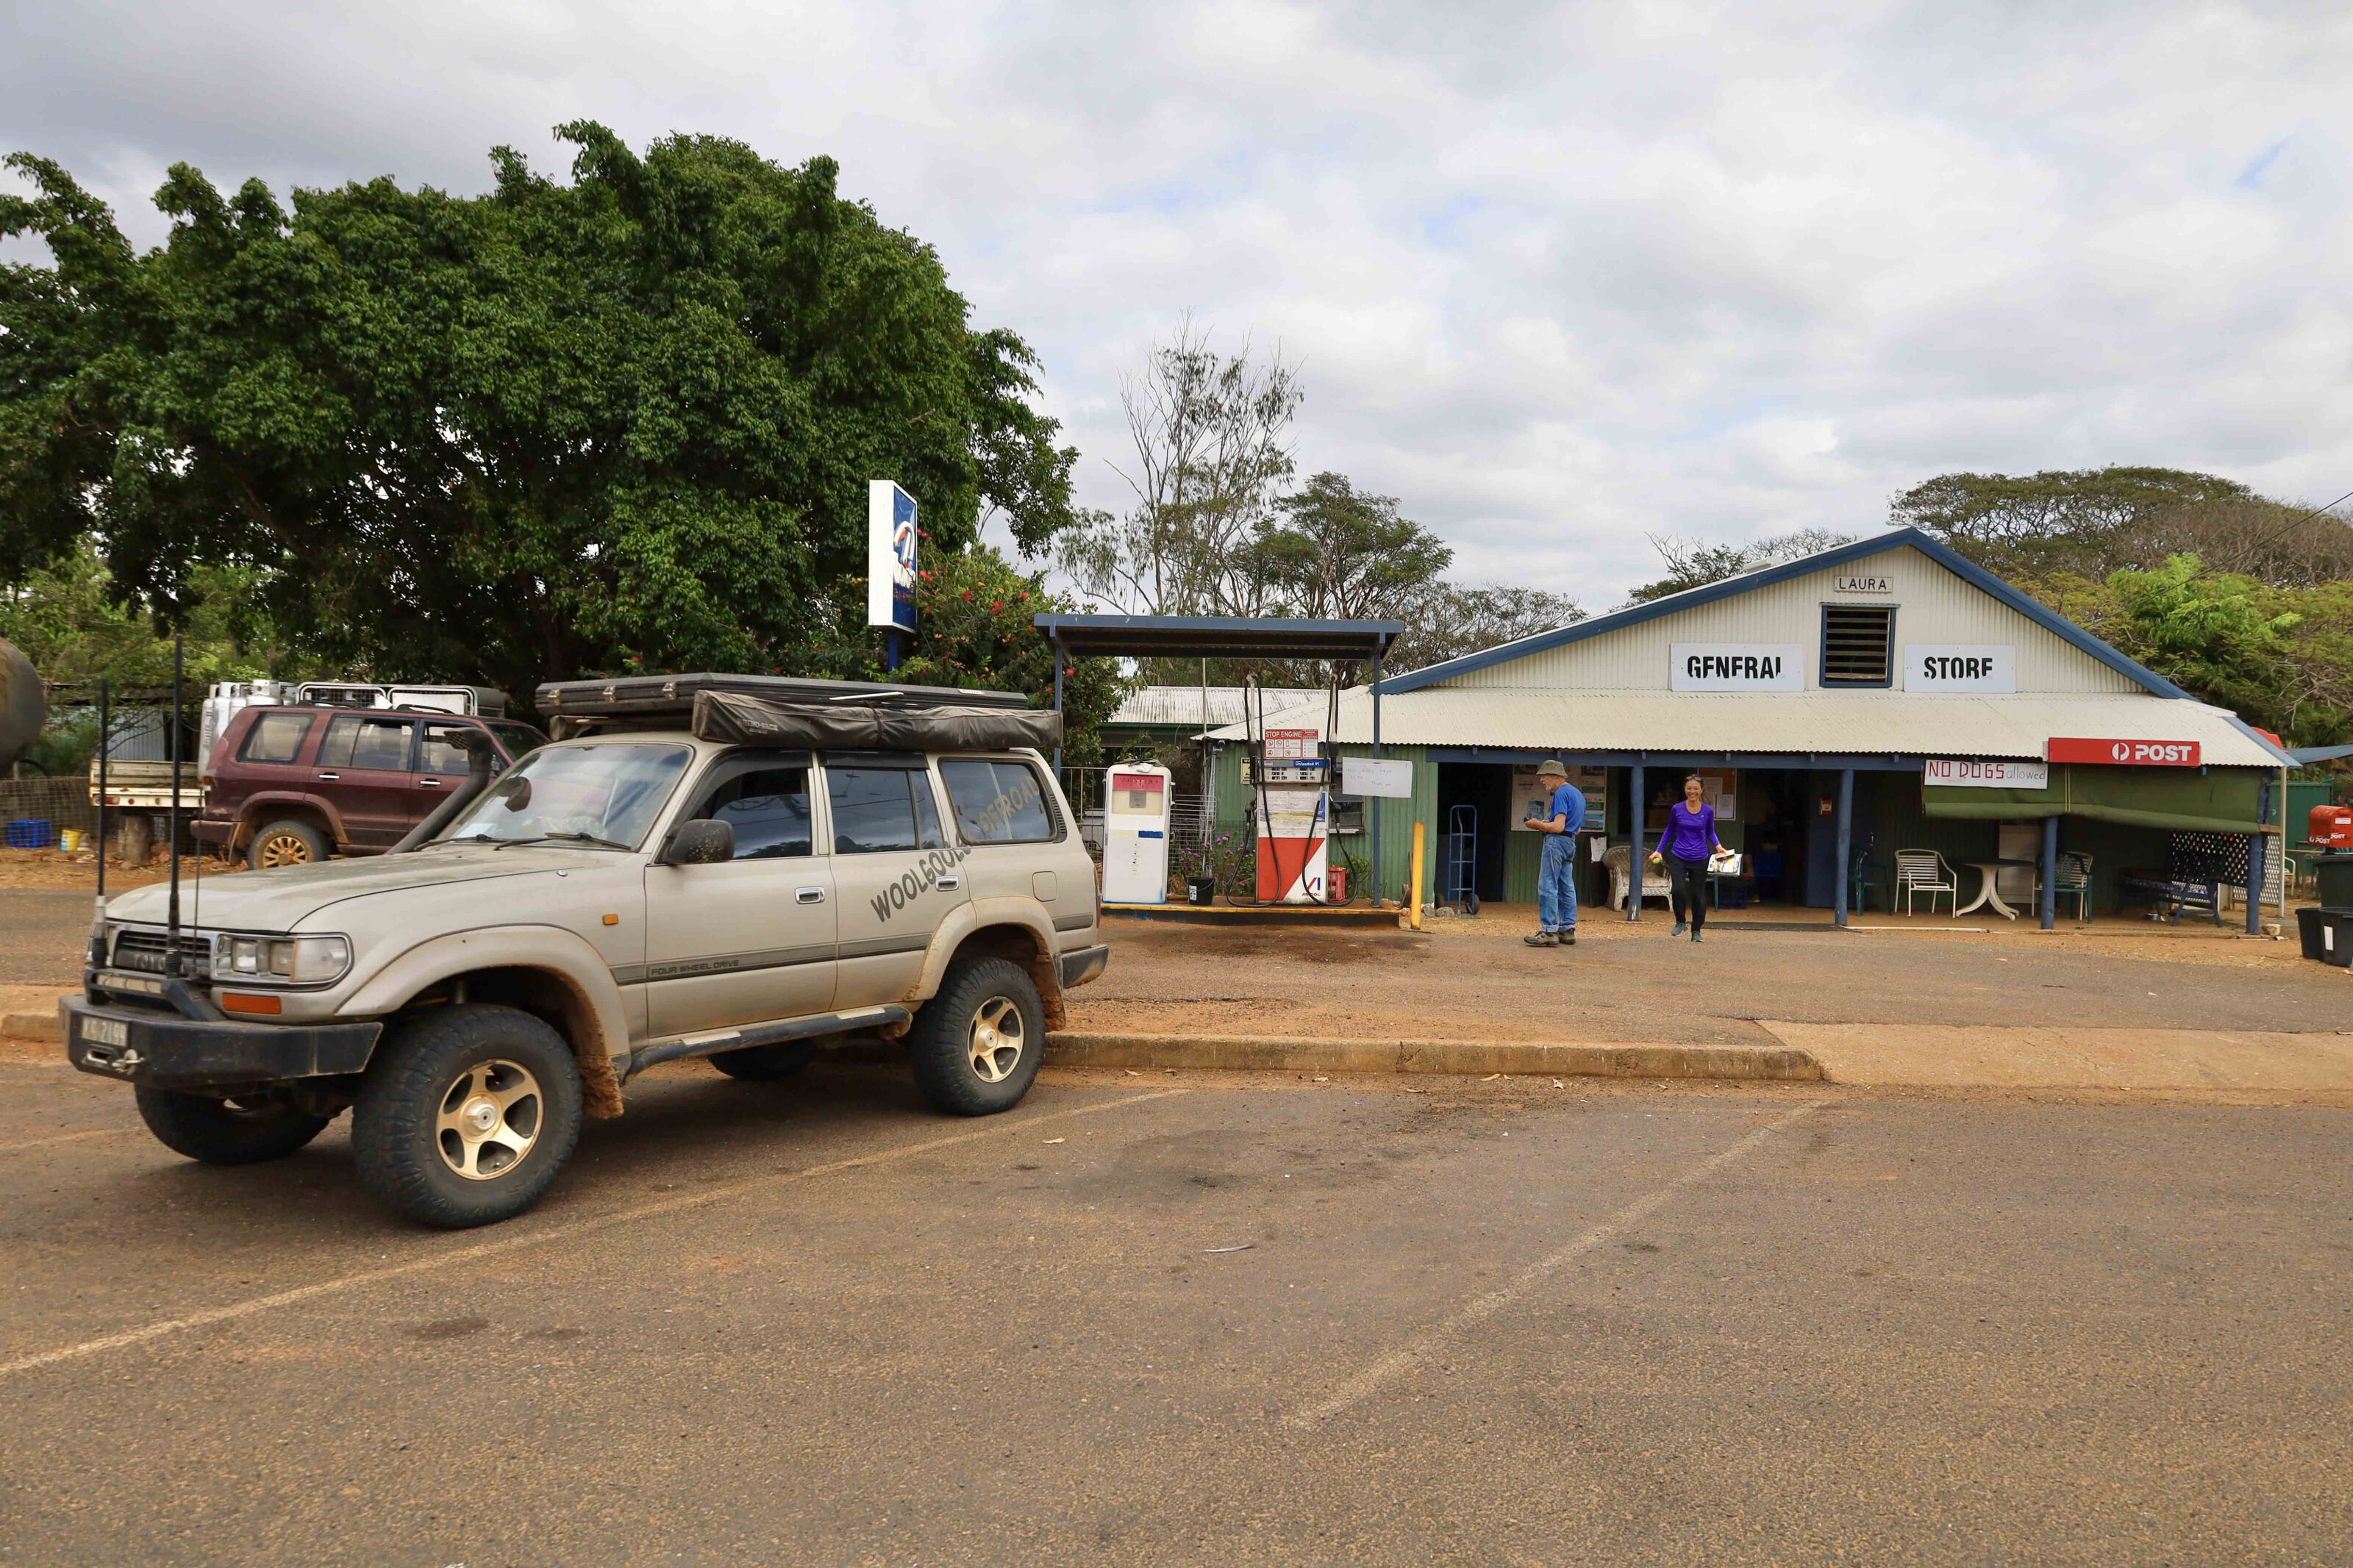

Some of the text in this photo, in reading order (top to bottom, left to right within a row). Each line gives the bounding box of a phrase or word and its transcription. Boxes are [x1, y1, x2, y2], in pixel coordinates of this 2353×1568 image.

[1839, 577, 1887, 590] LAURA
[2135, 743, 2192, 762] POST
[1929, 760, 2046, 781] NO DOGS allowed
[651, 960, 739, 975] FOUR WHEEL DRIVE
